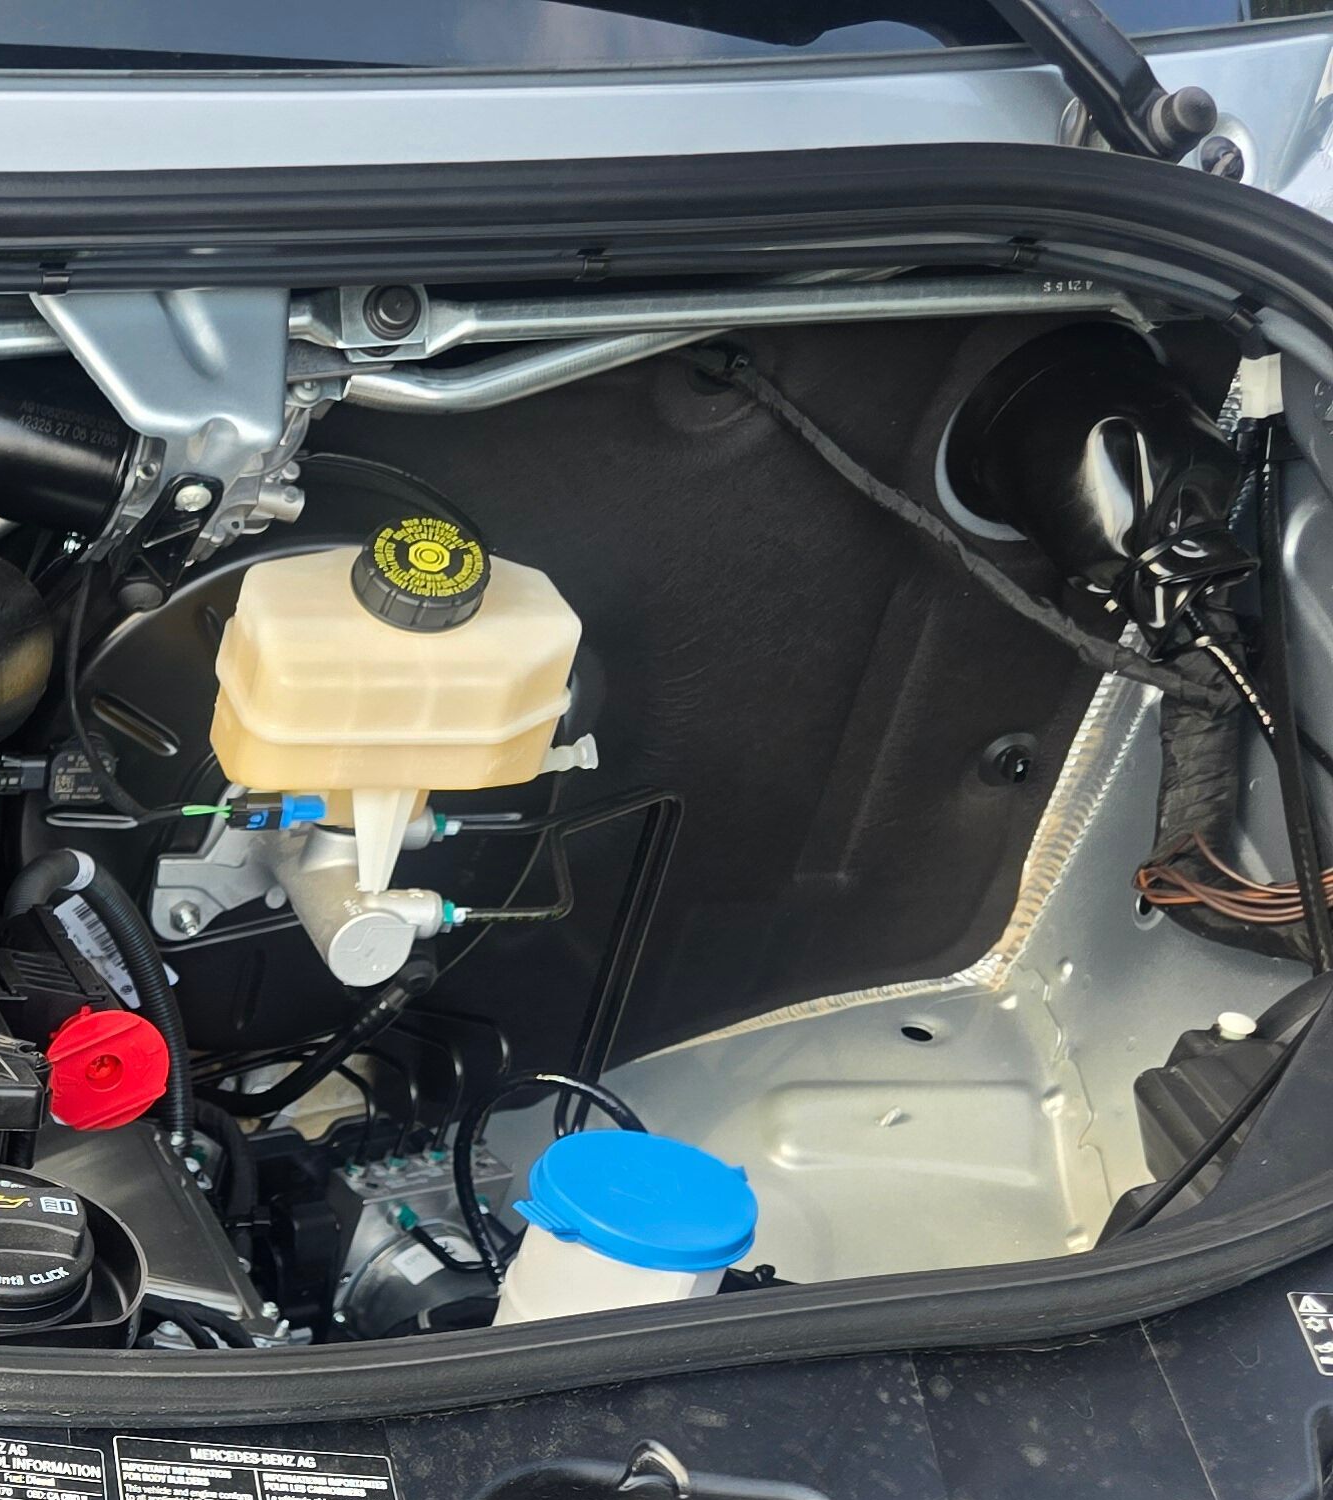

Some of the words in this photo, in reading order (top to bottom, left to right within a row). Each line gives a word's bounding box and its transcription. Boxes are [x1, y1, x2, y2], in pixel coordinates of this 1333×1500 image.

[29, 1266, 70, 1284] CLICK
[8, 1443, 28, 1456] AG
[190, 1448, 296, 1466] MERCEDES-BENZ
[297, 1456, 316, 1468] AG
[12, 1457, 102, 1478] INFORMATION
